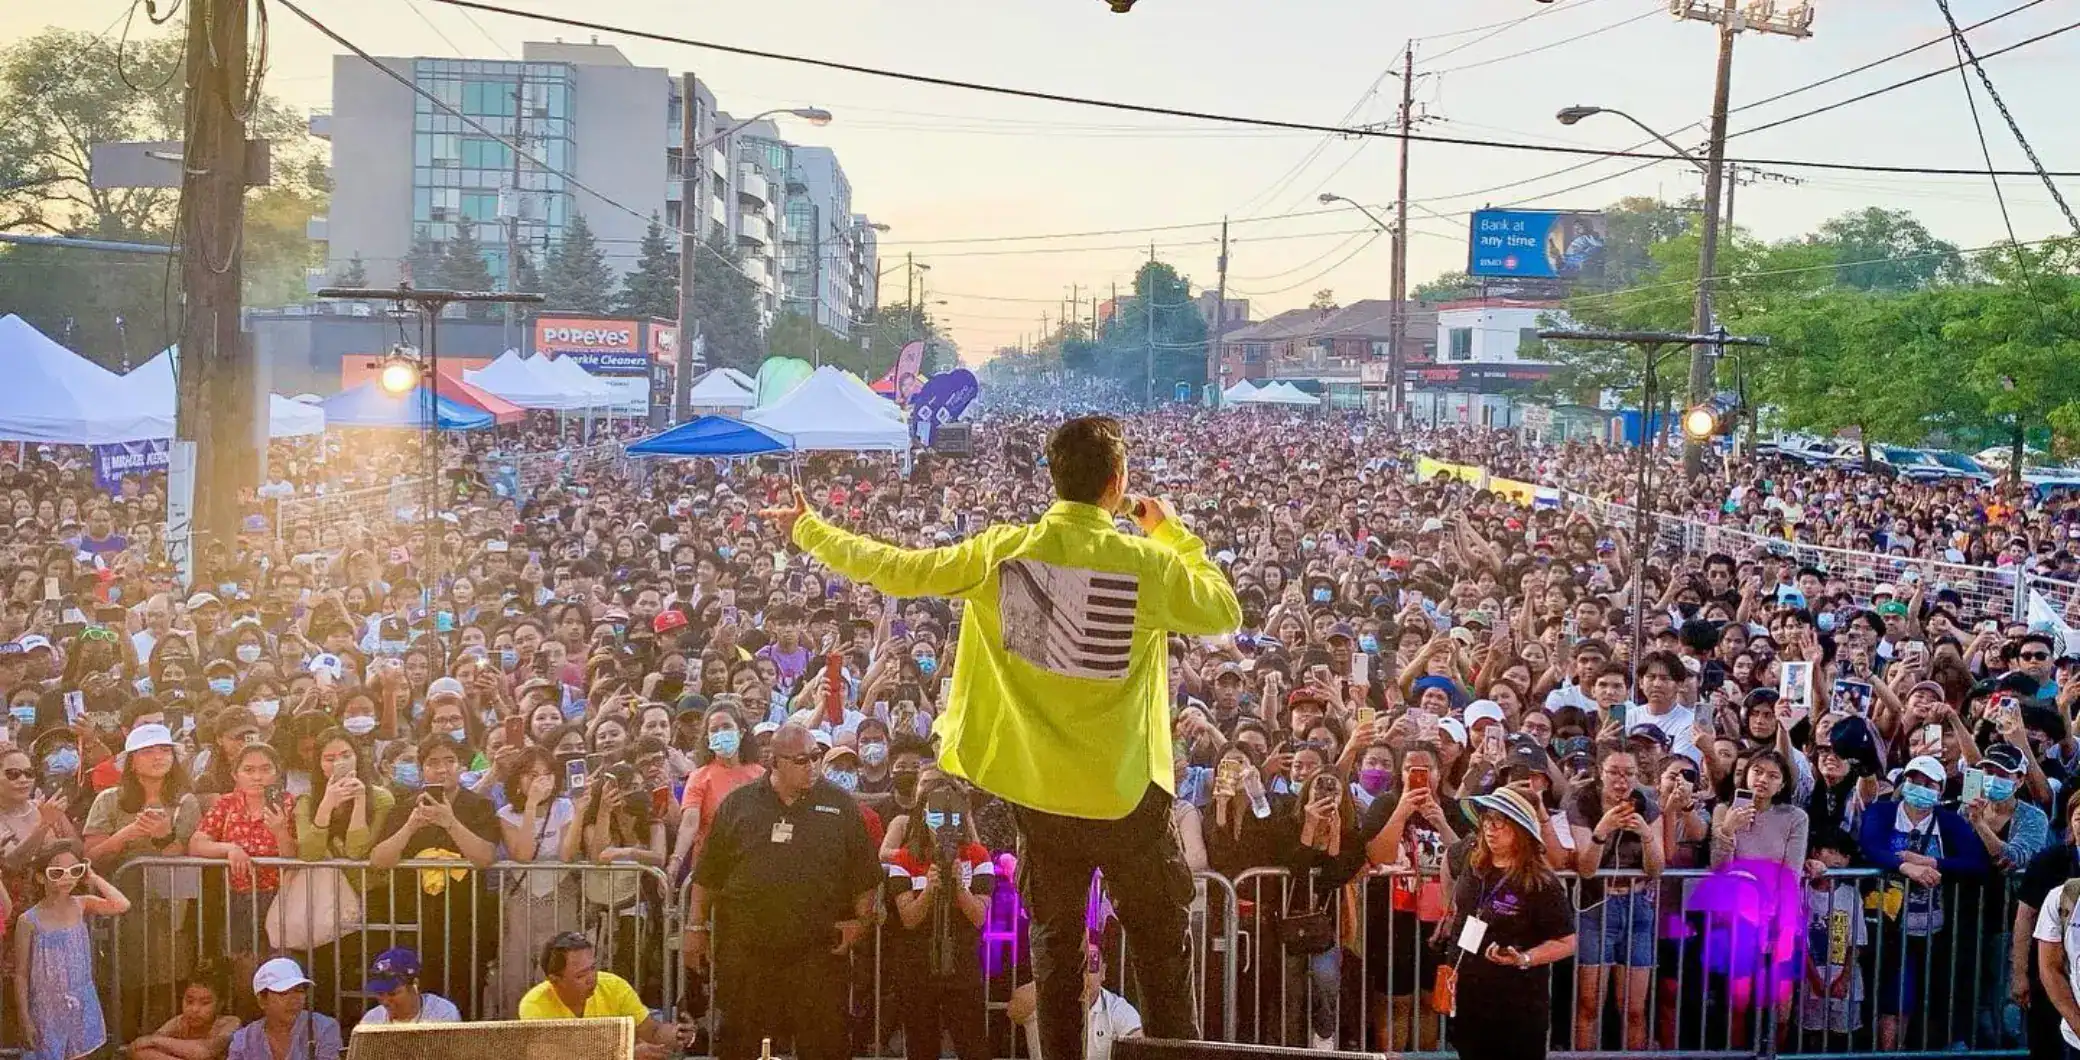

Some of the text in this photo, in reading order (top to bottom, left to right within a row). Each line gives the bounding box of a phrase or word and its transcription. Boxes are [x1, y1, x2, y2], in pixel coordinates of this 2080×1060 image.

[1480, 219, 1525, 231] Bank at
[1480, 235, 1536, 248] any time
[572, 354, 647, 366] arkle Cleaners
